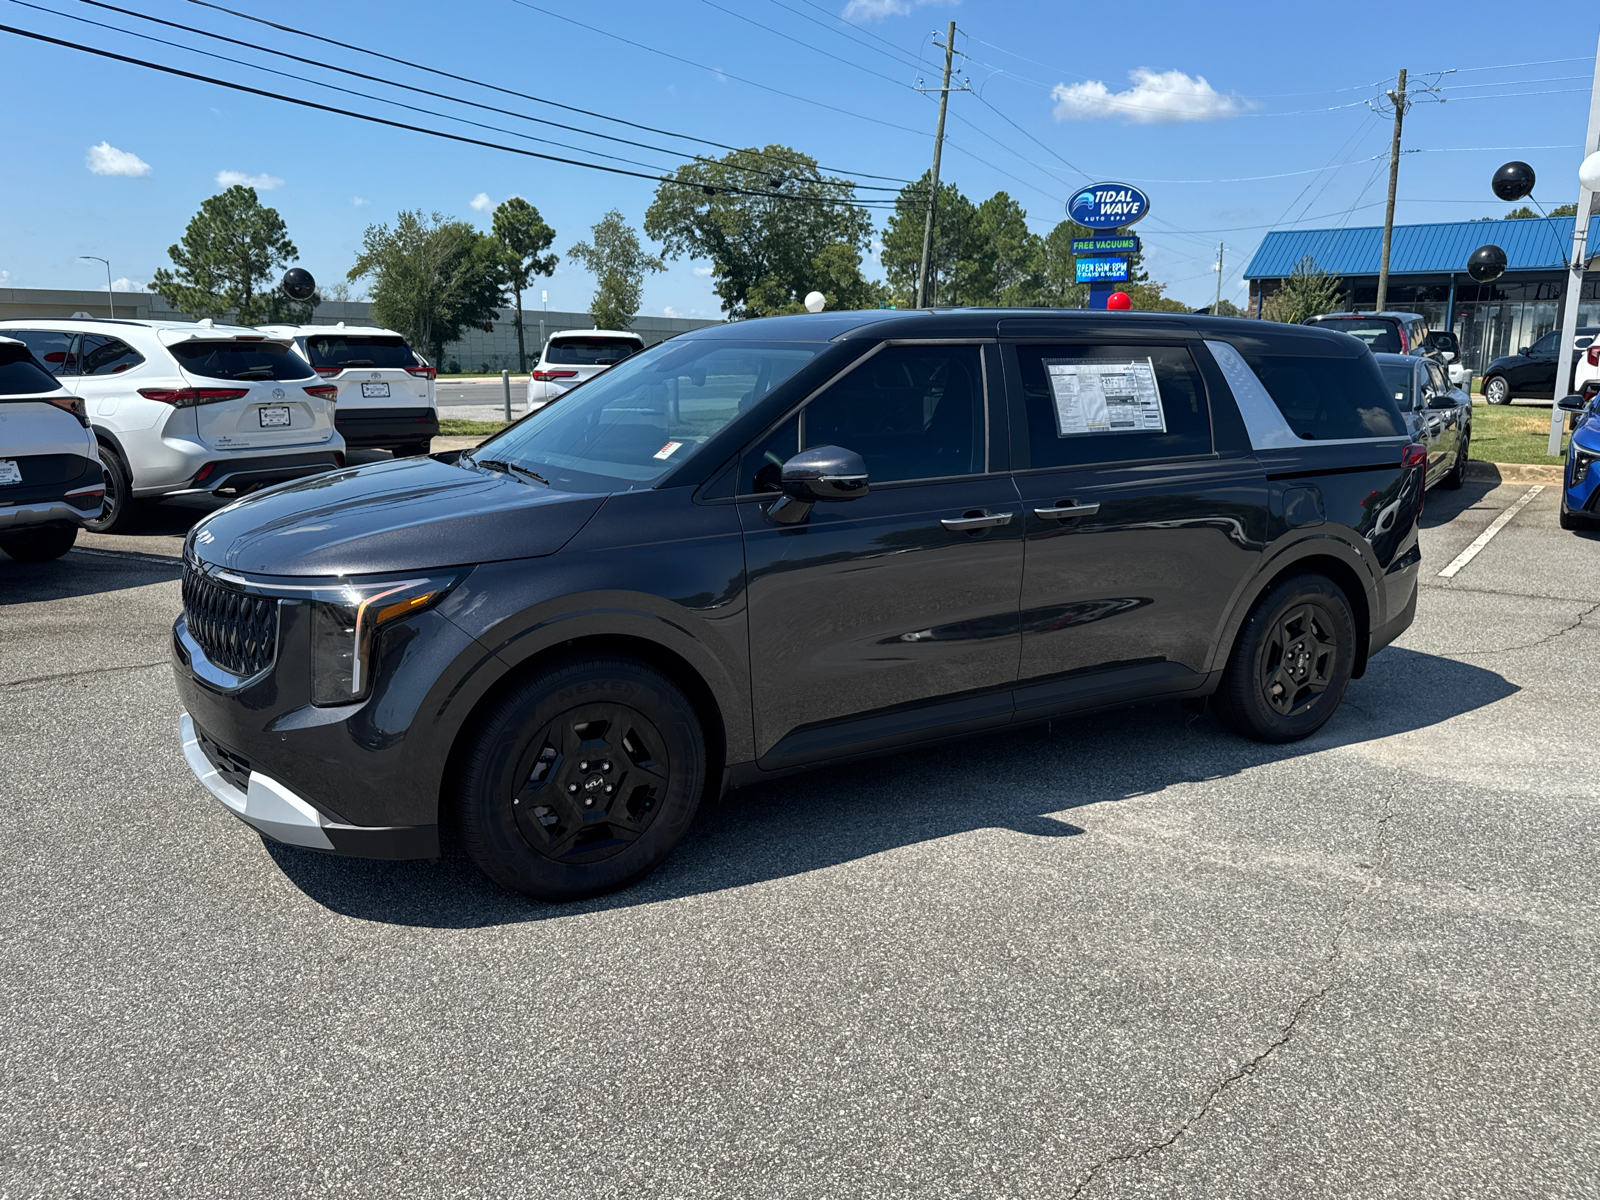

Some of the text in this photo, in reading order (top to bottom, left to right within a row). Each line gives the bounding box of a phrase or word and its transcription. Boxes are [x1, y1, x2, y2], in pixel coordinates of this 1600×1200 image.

[1095, 190, 1133, 203] TIDAL
[1100, 202, 1140, 215] WAVE
[1073, 239, 1134, 250] FREE VACUUMS
[557, 680, 641, 702] NEXEN
